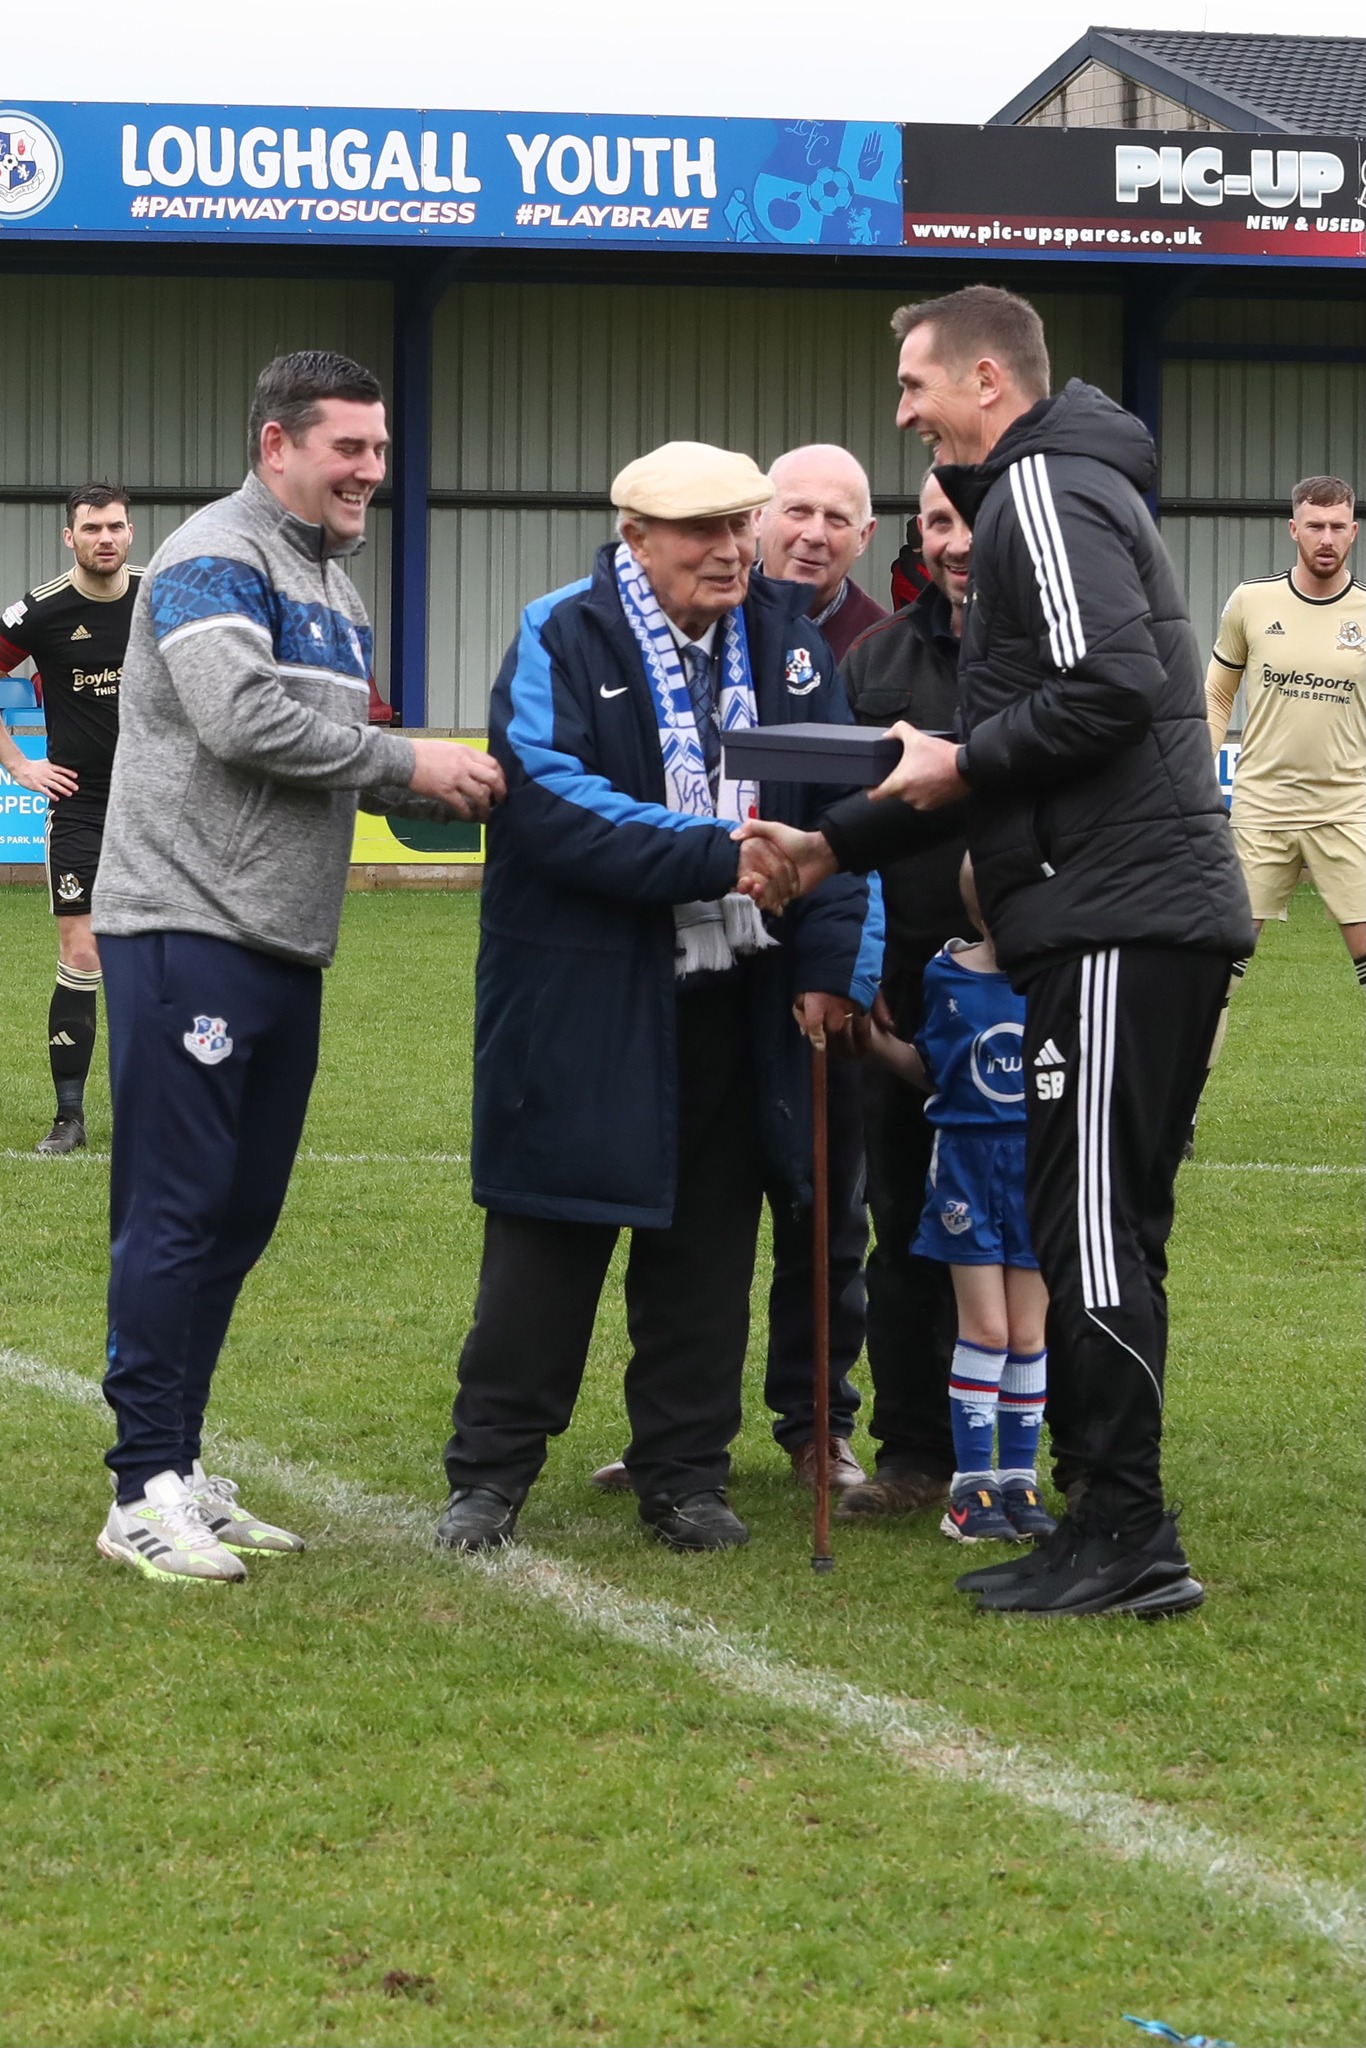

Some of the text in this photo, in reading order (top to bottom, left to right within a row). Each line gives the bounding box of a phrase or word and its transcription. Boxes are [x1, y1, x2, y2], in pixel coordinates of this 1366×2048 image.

[121, 124, 718, 198] LOUGHGALL YOUTH
[1114, 144, 1345, 208] PIC-UP
[130, 196, 476, 224] #PATHWAYTOSUCCESS
[515, 203, 709, 231] #PLAYBRAVE
[1246, 215, 1366, 232] NEW & USED
[912, 220, 1202, 246] www.pic-upspares.co.uk
[94, 686, 117, 696] THIS
[1263, 670, 1356, 692] BoyleSports
[1278, 688, 1299, 698] THIS
[1300, 690, 1311, 699] IS
[1035, 1071, 1065, 1100] SB
